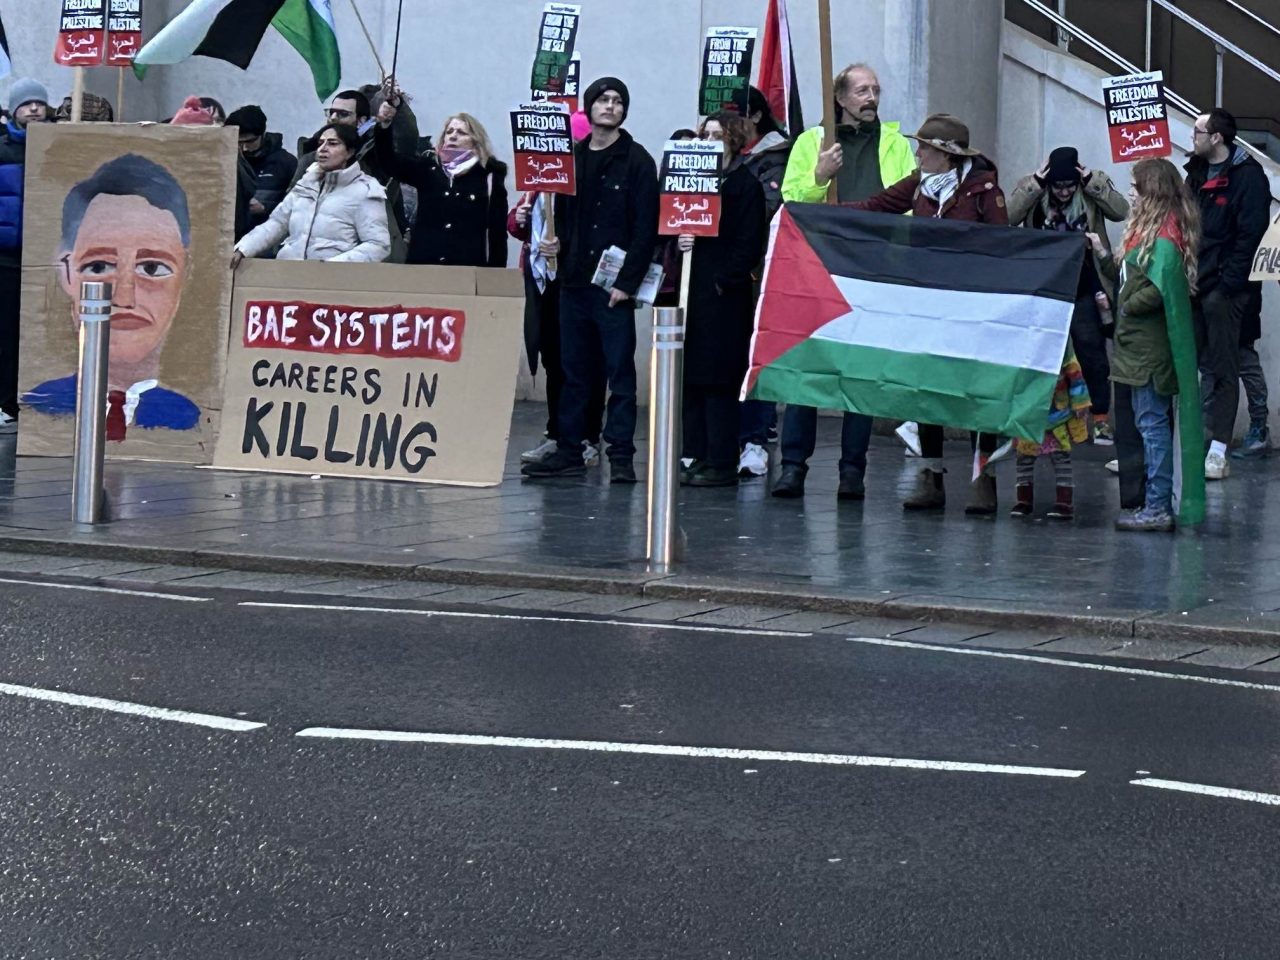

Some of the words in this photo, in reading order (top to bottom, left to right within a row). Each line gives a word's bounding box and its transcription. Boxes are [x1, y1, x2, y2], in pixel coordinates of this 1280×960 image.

[731, 51, 743, 64] TO
[723, 63, 738, 76] SEA
[1108, 84, 1159, 103] FREEDOM
[516, 114, 567, 131] FREEDOM
[1109, 104, 1164, 124] PALESTINE
[516, 135, 571, 153] PALESTINE
[668, 153, 718, 170] FREEDOM
[664, 176, 719, 193] PALESTINE
[247, 305, 299, 343] BAE
[309, 308, 456, 355] SYSTEMS
[252, 359, 381, 405] CAREERS
[403, 372, 438, 408] IN
[242, 397, 437, 473] KILLING
